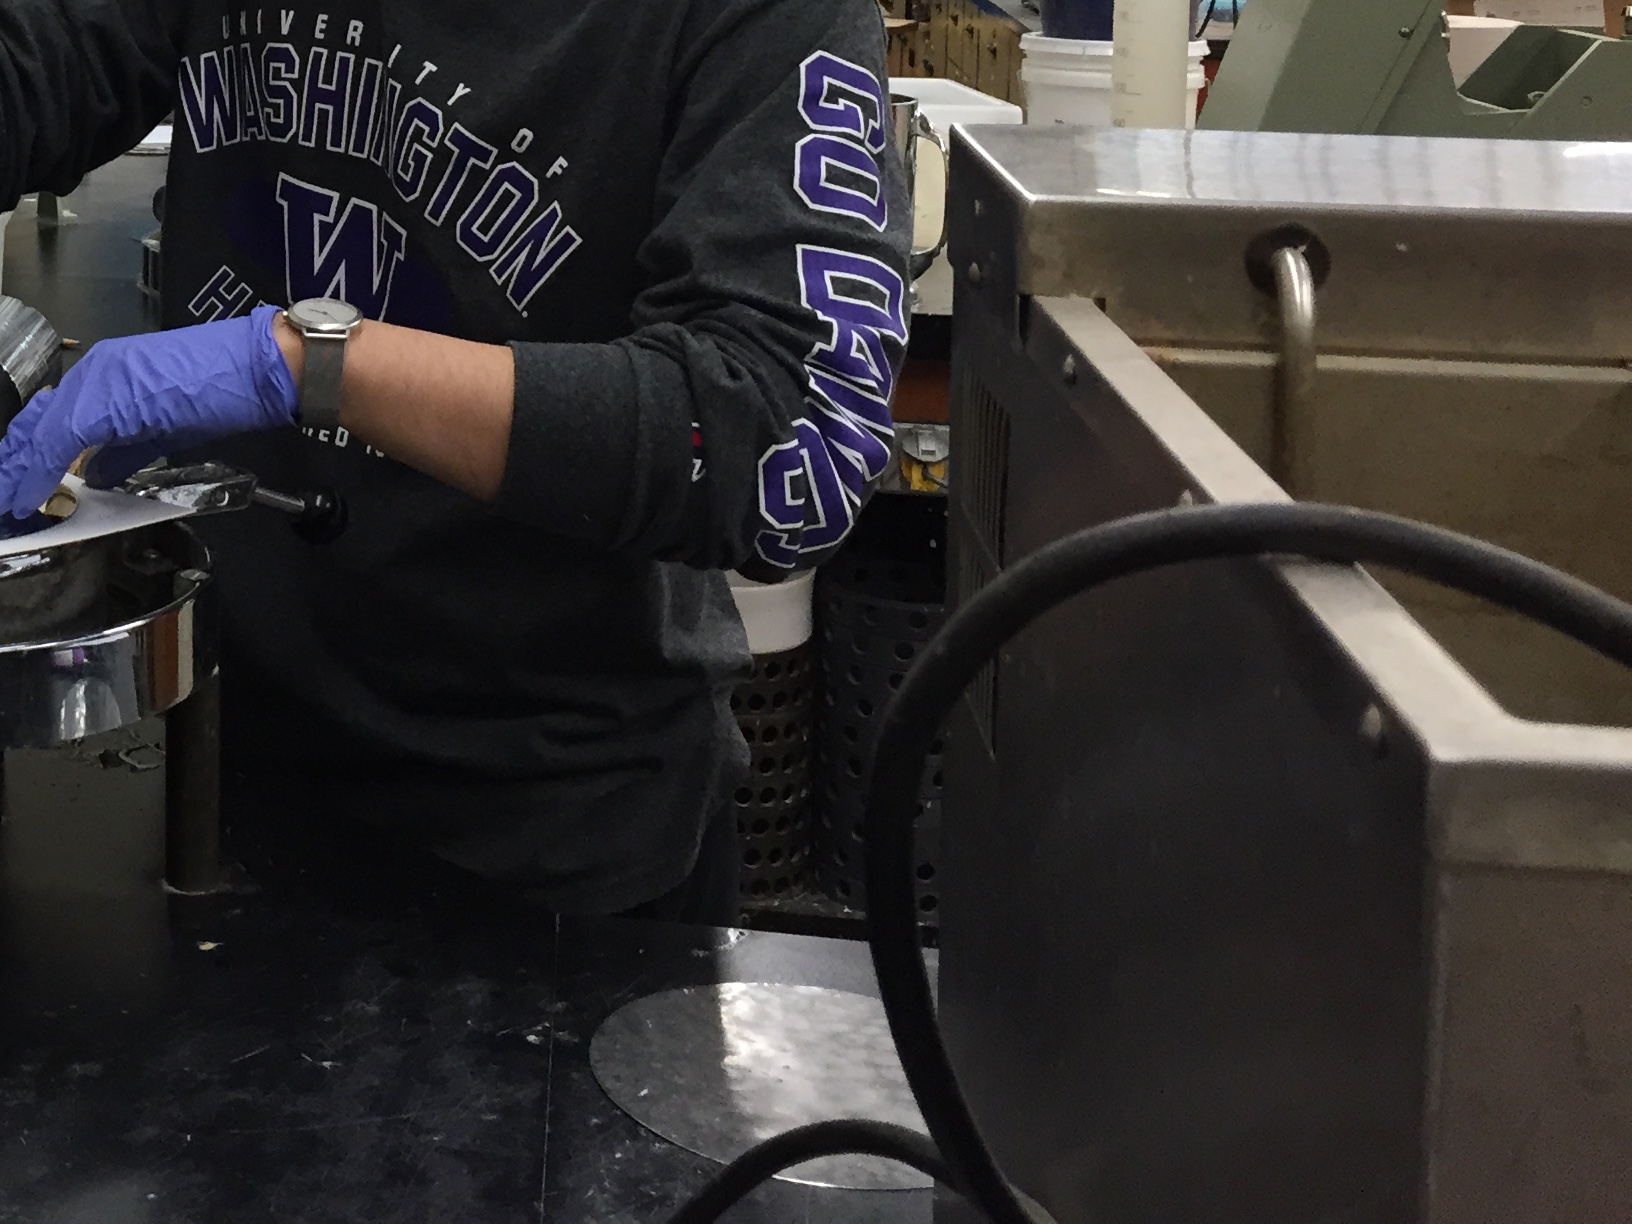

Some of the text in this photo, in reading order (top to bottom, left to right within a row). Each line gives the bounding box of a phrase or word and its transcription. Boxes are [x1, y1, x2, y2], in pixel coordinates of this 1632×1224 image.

[177, 41, 583, 312] WASHINGTON
[510, 127, 569, 179] OF
[792, 49, 888, 233] GO
